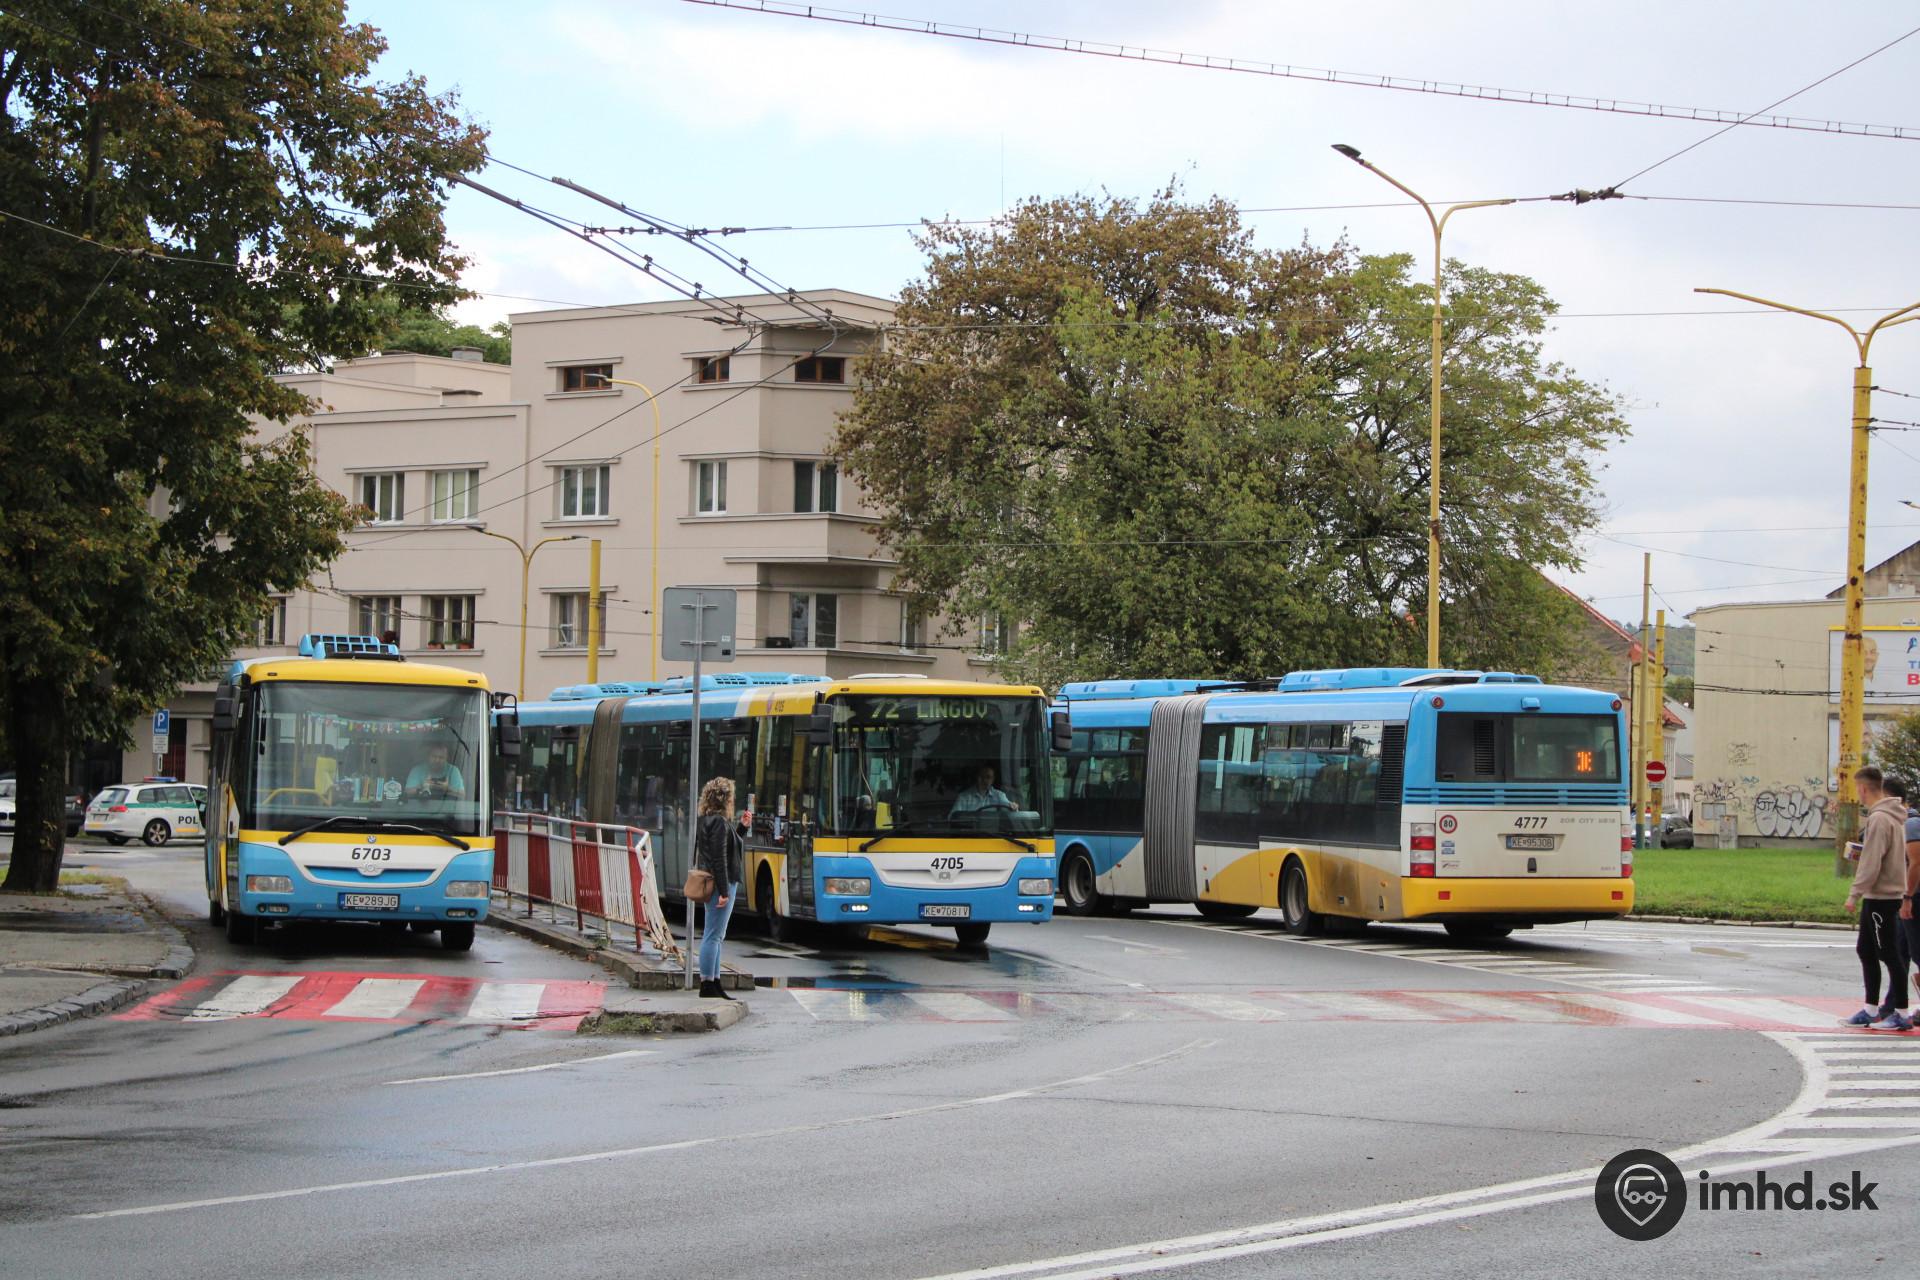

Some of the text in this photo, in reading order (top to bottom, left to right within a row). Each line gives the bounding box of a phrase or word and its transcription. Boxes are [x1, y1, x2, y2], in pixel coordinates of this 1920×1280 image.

[1908, 660, 1920, 669] T
[1907, 674, 1920, 685] B
[871, 700, 899, 719] 72
[157, 712, 165, 727] P
[1443, 819, 1453, 828] 80
[1514, 816, 1548, 829] 4777
[351, 847, 392, 861] 6703
[930, 856, 964, 870] 4705
